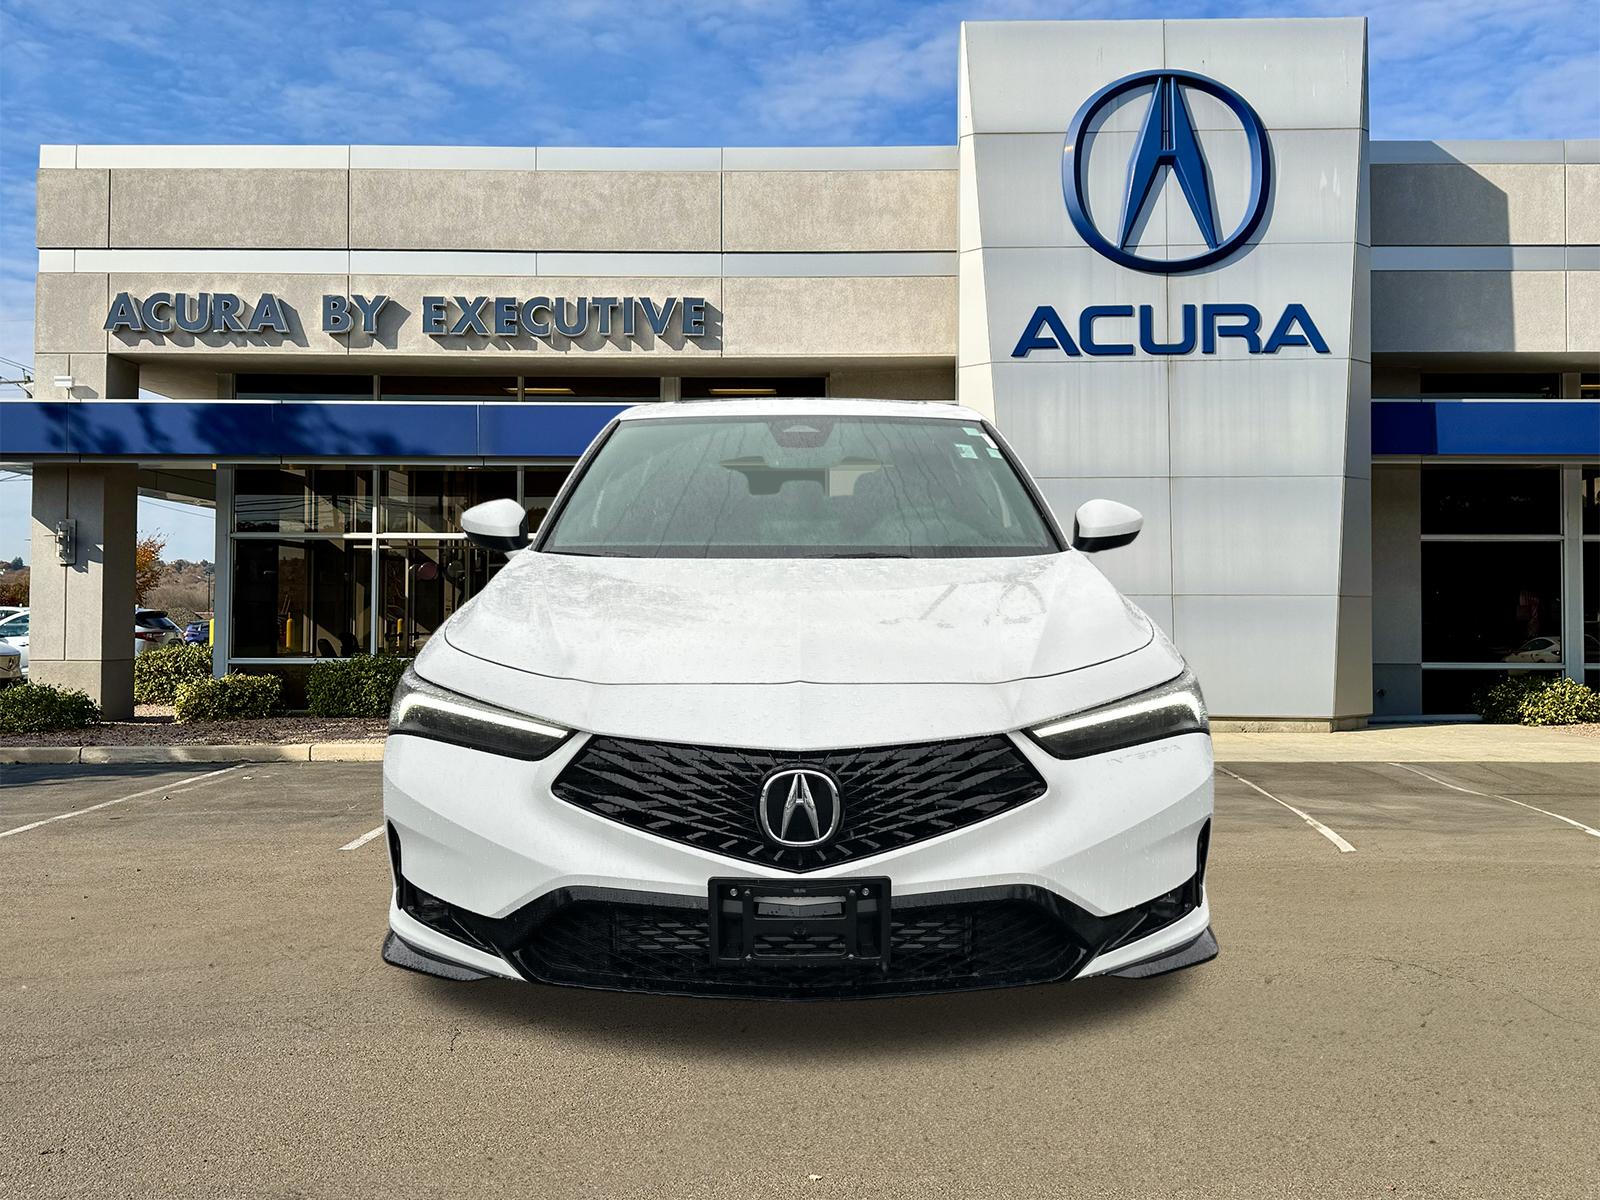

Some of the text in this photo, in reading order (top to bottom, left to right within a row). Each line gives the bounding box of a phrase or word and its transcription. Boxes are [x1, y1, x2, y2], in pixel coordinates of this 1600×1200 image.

[104, 292, 708, 338] ACURA BY EXECUTIVE
[1010, 303, 1331, 358] ACURA
